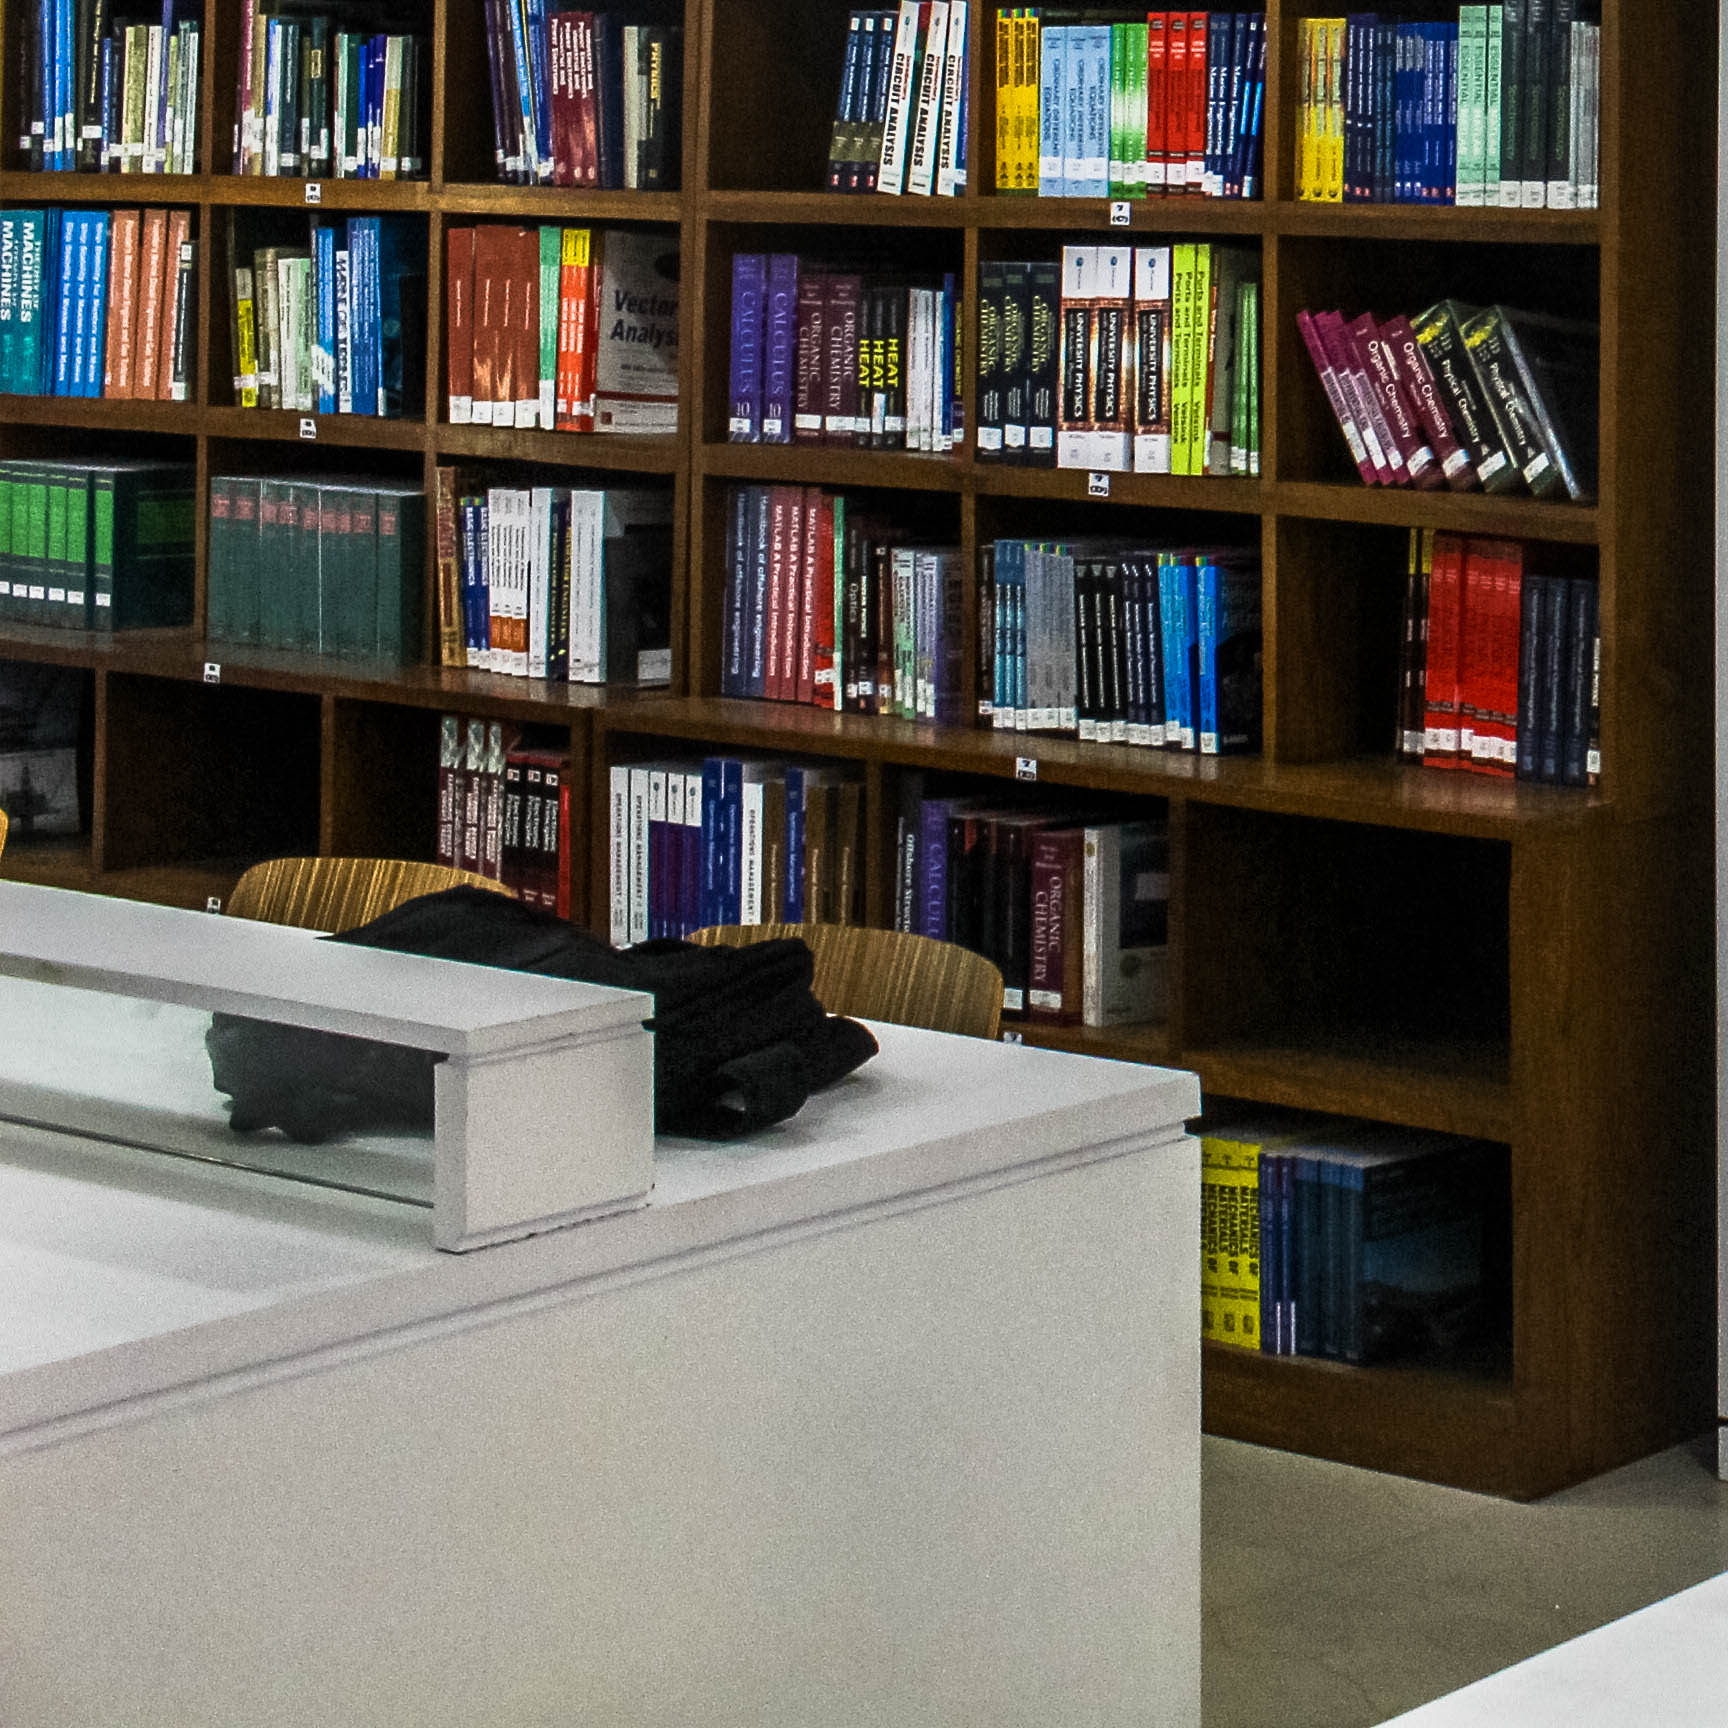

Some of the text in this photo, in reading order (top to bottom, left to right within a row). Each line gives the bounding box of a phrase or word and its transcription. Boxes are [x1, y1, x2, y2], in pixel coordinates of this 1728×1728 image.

[883, 53, 905, 166] CIRCUIT ANALYSIS
[913, 54, 935, 167] CIRCUIT ANALYSIS
[21, 221, 34, 323] MACHINES
[610, 318, 678, 348] Analys
[772, 292, 787, 395] CALCULUS
[829, 326, 842, 410] CHEMISTRY
[843, 312, 855, 381] ORGANIC
[859, 339, 870, 388] HEAT
[872, 340, 884, 388] HEAT
[888, 338, 899, 388] HEAT
[1074, 312, 1084, 418] UNIVERSITY PHYSICS
[1105, 312, 1117, 418] UNIVERSITY PHYSICS
[1368, 340, 1390, 390] Organic
[1403, 341, 1425, 390] Organic
[1033, 891, 1048, 982] CHEMISTRY
[1049, 876, 1062, 953] ORGANIC
